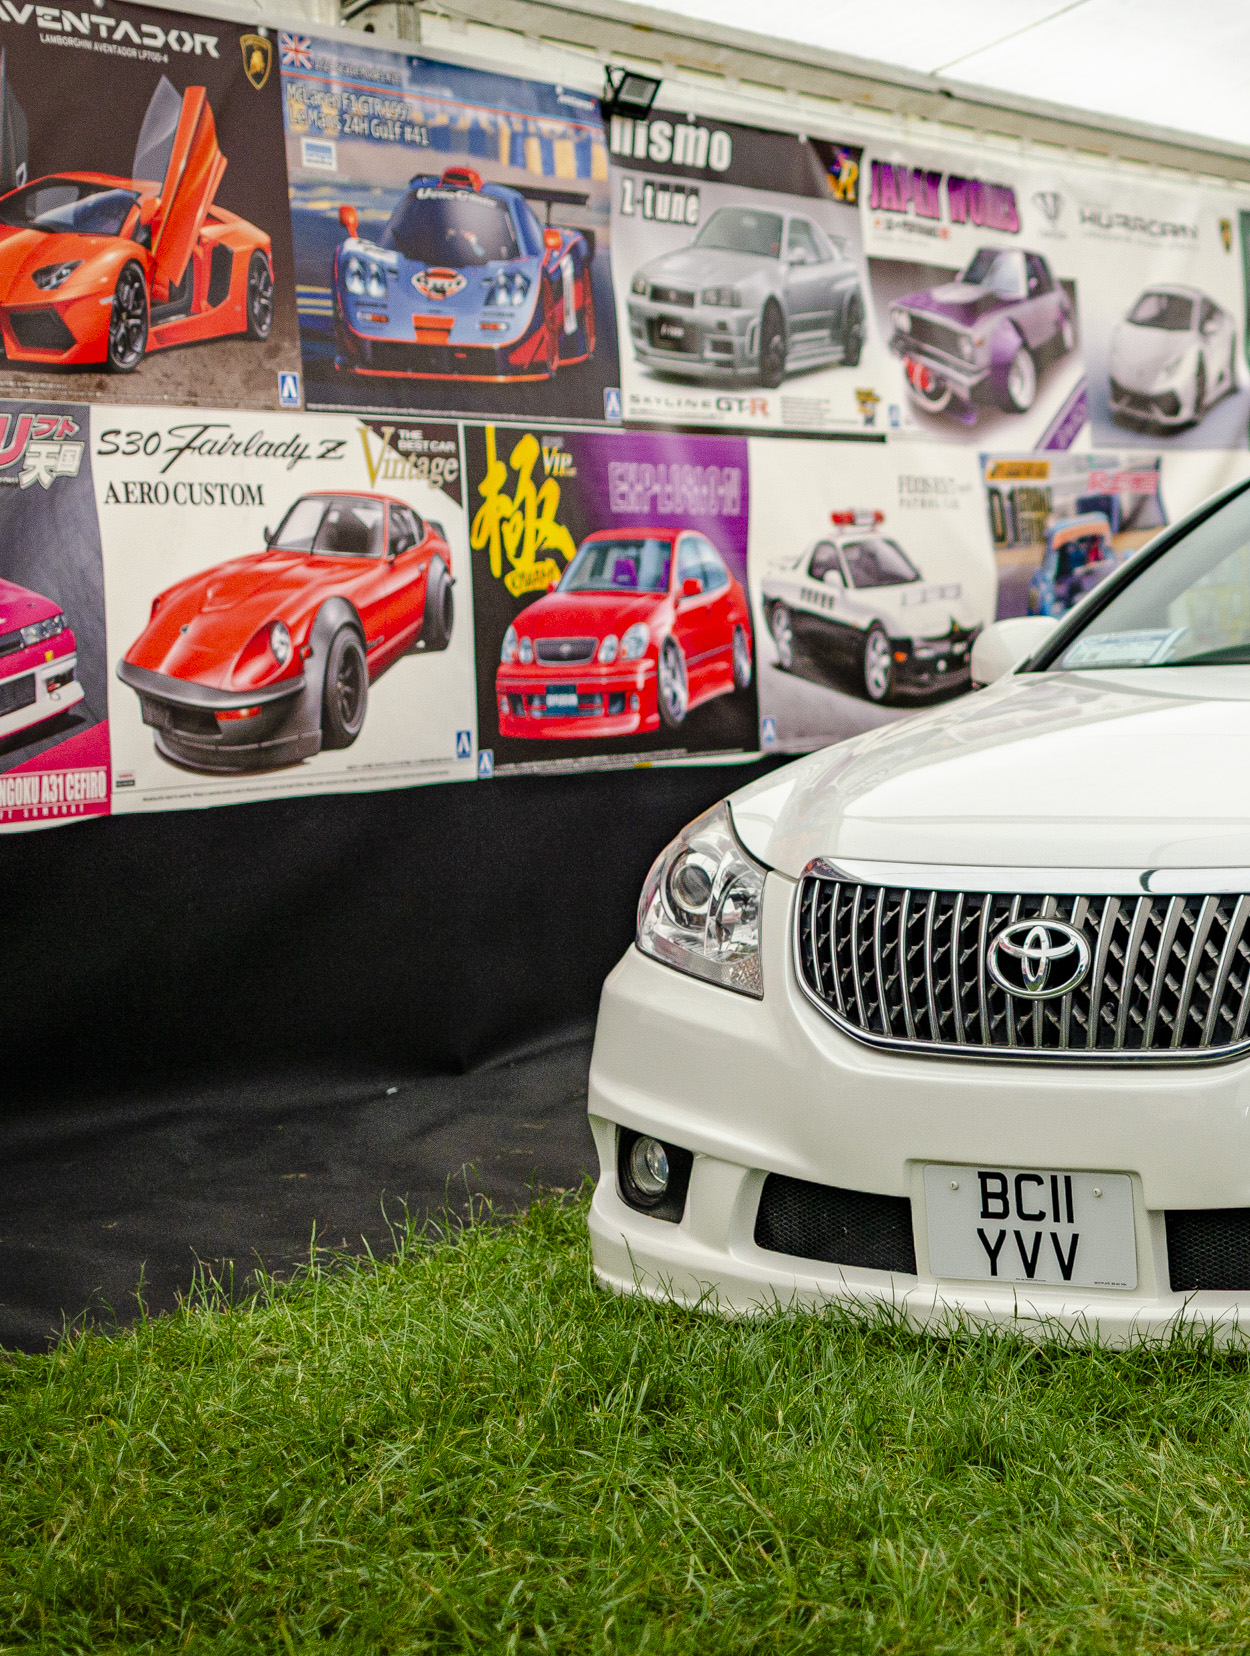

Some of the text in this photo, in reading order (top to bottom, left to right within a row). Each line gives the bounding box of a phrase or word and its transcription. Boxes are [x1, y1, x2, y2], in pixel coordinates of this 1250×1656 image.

[39, 32, 93, 50] LAMBORGHINI
[93, 41, 138, 58] AVENTADOR
[358, 95, 382, 117] GTR
[342, 113, 369, 135] 24H
[610, 114, 732, 172] nismo
[621, 177, 699, 226] Z-tune
[629, 393, 713, 409] SKYLINE
[97, 424, 348, 474] S30 Fairlady Z
[397, 428, 424, 440] THE
[356, 425, 460, 489] Vintage
[103, 481, 266, 506] AERO CUSTOM
[41, 774, 64, 803] A31
[65, 769, 107, 801] CEFIRO
[976, 1228, 1080, 1281] YVV
